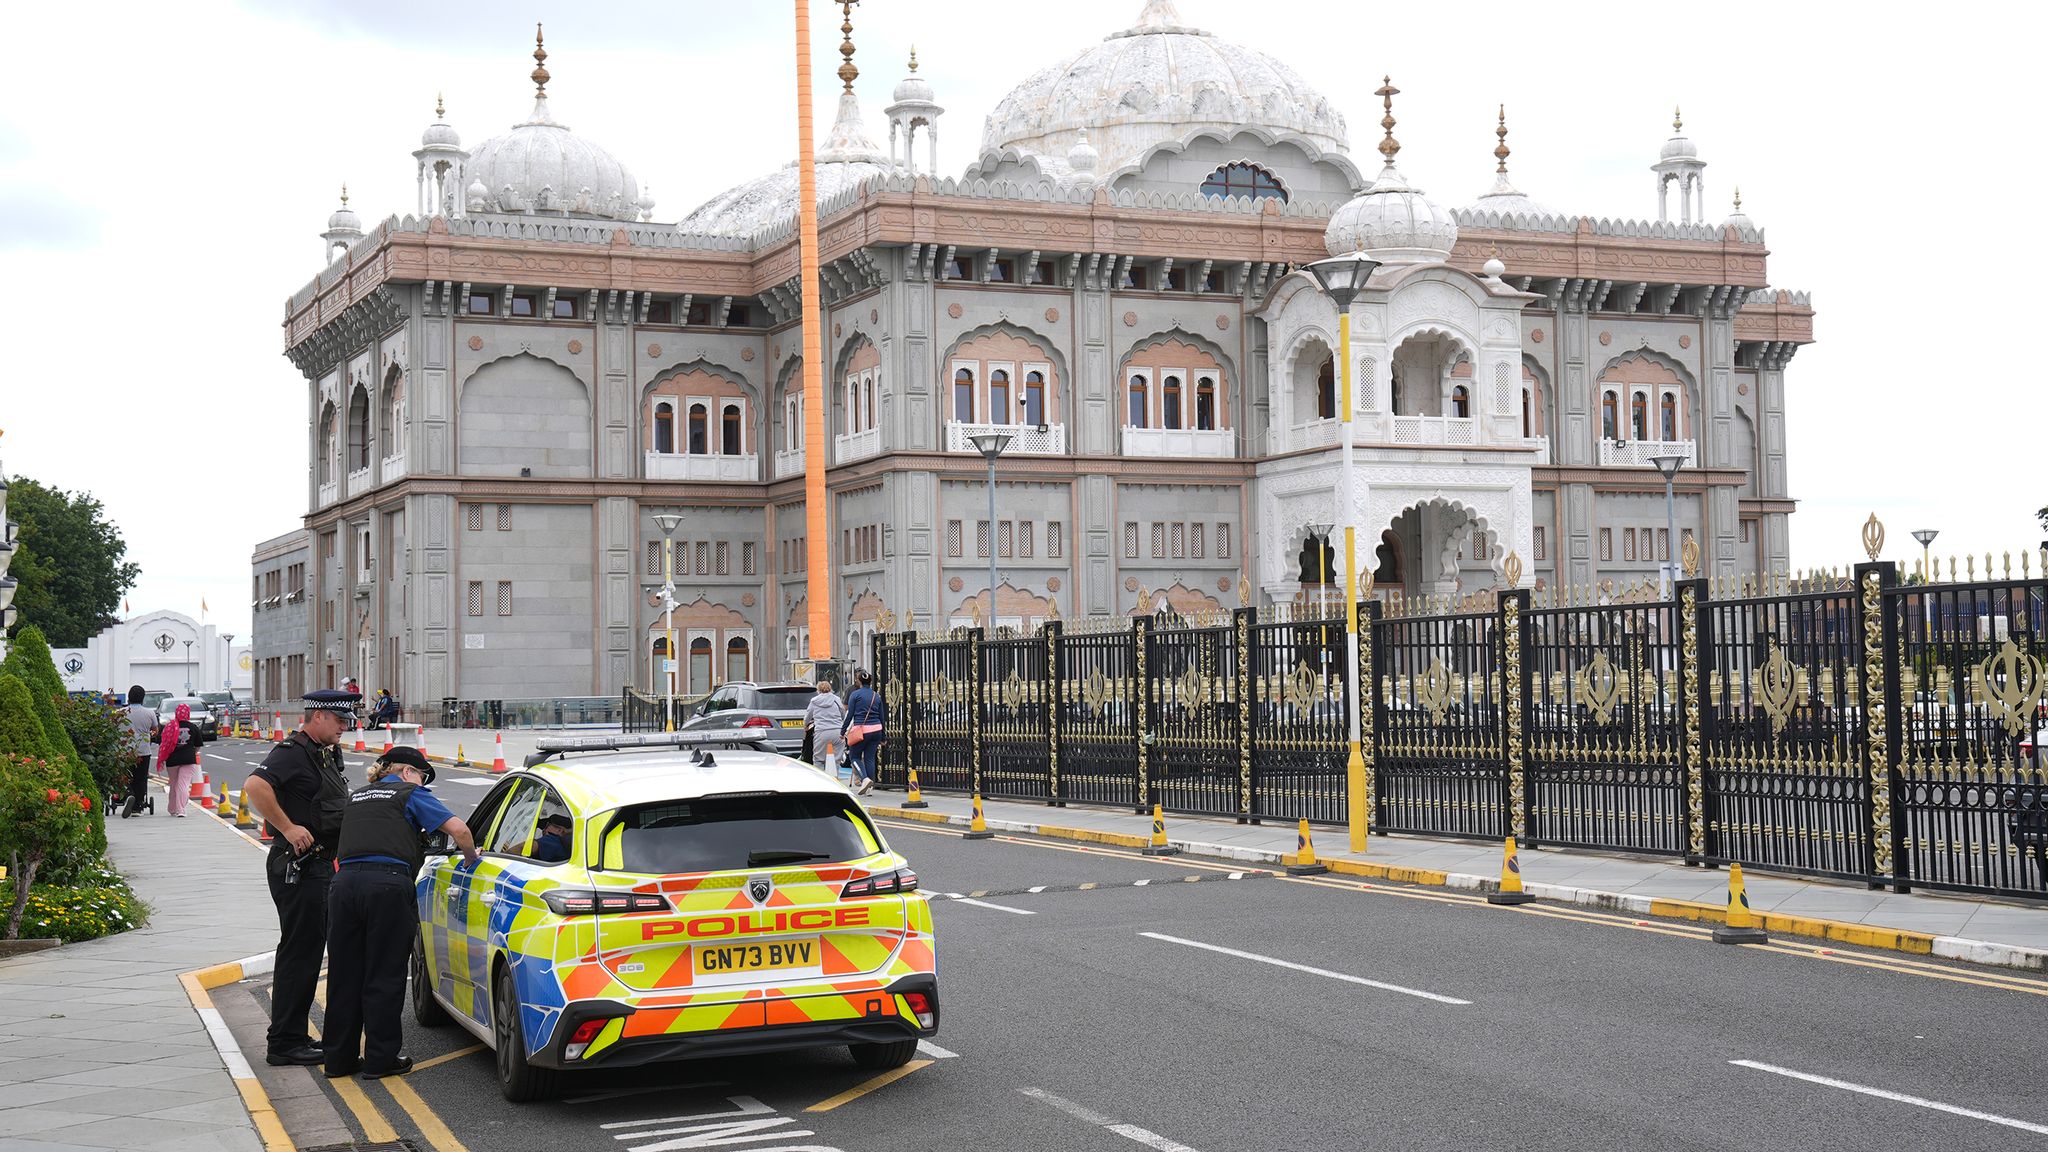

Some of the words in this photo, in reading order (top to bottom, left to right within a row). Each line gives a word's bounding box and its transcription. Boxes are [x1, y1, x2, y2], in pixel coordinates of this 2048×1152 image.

[641, 906, 870, 941] POLICE
[702, 946, 762, 971] GN73
[769, 942, 811, 966] BVV
